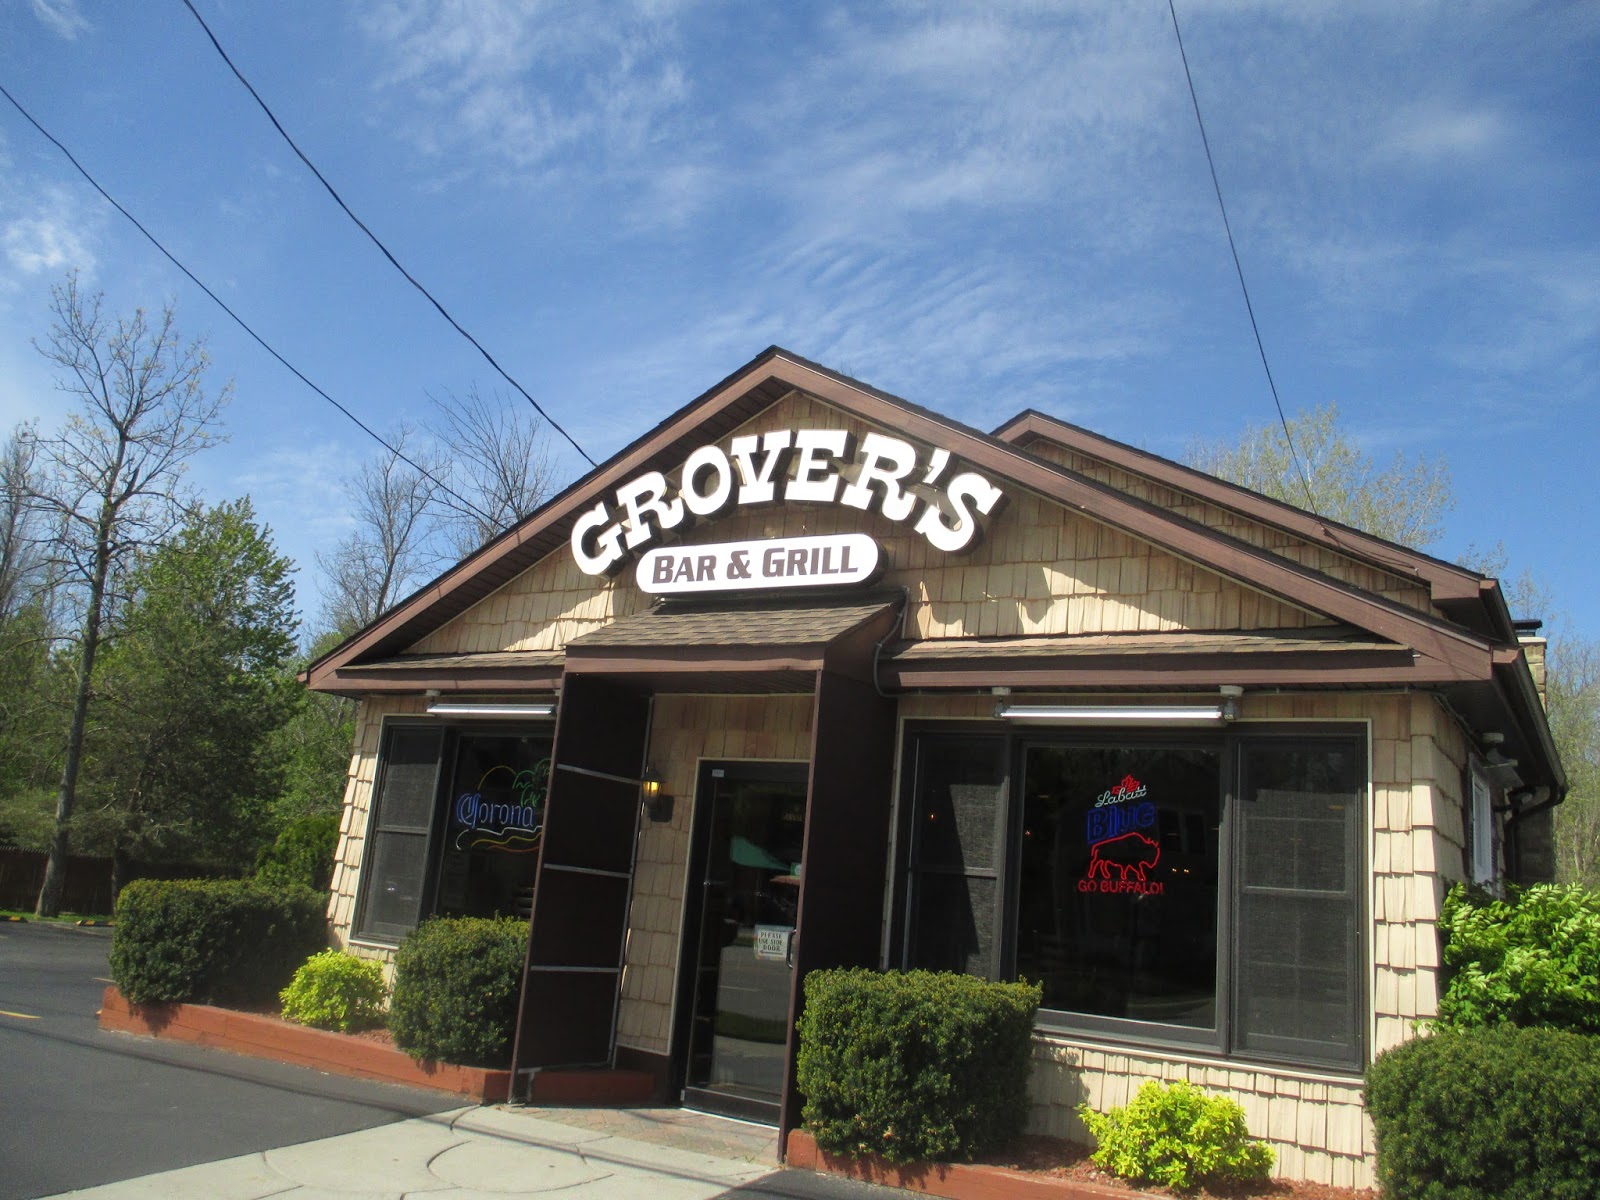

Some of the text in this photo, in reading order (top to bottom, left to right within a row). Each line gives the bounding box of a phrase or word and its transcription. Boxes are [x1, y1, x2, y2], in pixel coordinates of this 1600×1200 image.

[571, 429, 1003, 575] GROVER'S
[652, 546, 858, 584] BAR & GRILL
[456, 793, 534, 829] Corona
[1095, 785, 1147, 808] Labatt
[1087, 802, 1156, 844] Blue
[1078, 880, 1164, 894] GO BUFFALO!
[760, 931, 782, 939] PLEASE
[763, 944, 781, 952] DOOR
